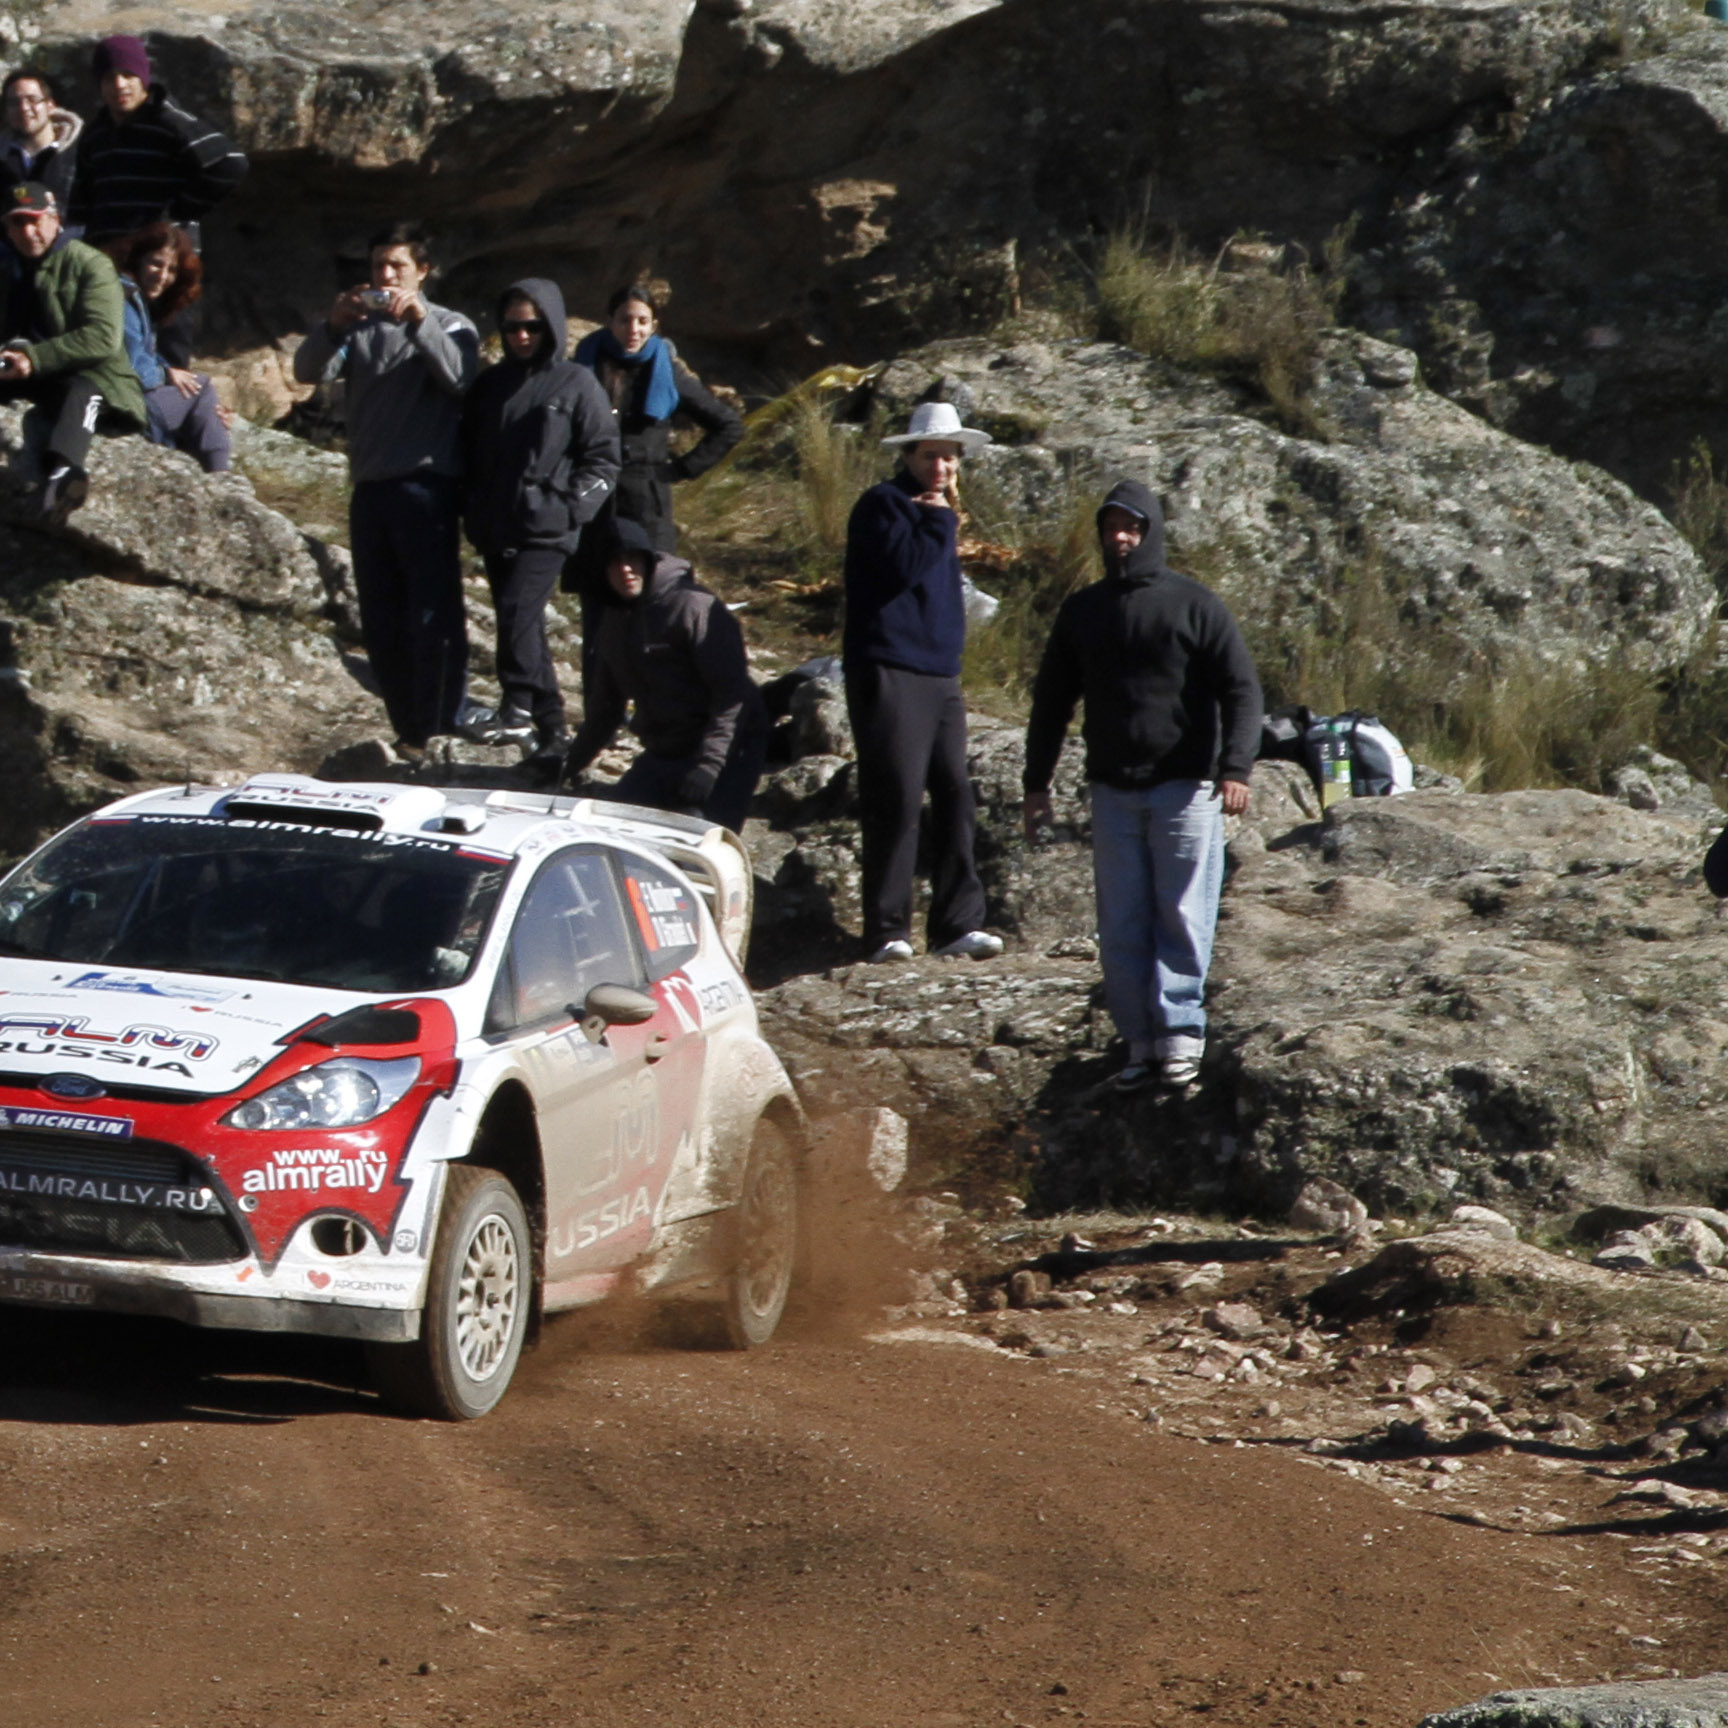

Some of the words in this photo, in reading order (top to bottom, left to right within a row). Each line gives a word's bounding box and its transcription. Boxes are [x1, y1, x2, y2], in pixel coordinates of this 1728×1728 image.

[141, 814, 451, 852] www.almrally.ru
[50, 1078, 90, 1098] Ford
[14, 1111, 126, 1136] MICHELIN
[359, 1149, 388, 1163] ru
[242, 1160, 387, 1193] almrally
[550, 1185, 652, 1259] USSIA
[332, 1279, 407, 1292] ARGENTINA
